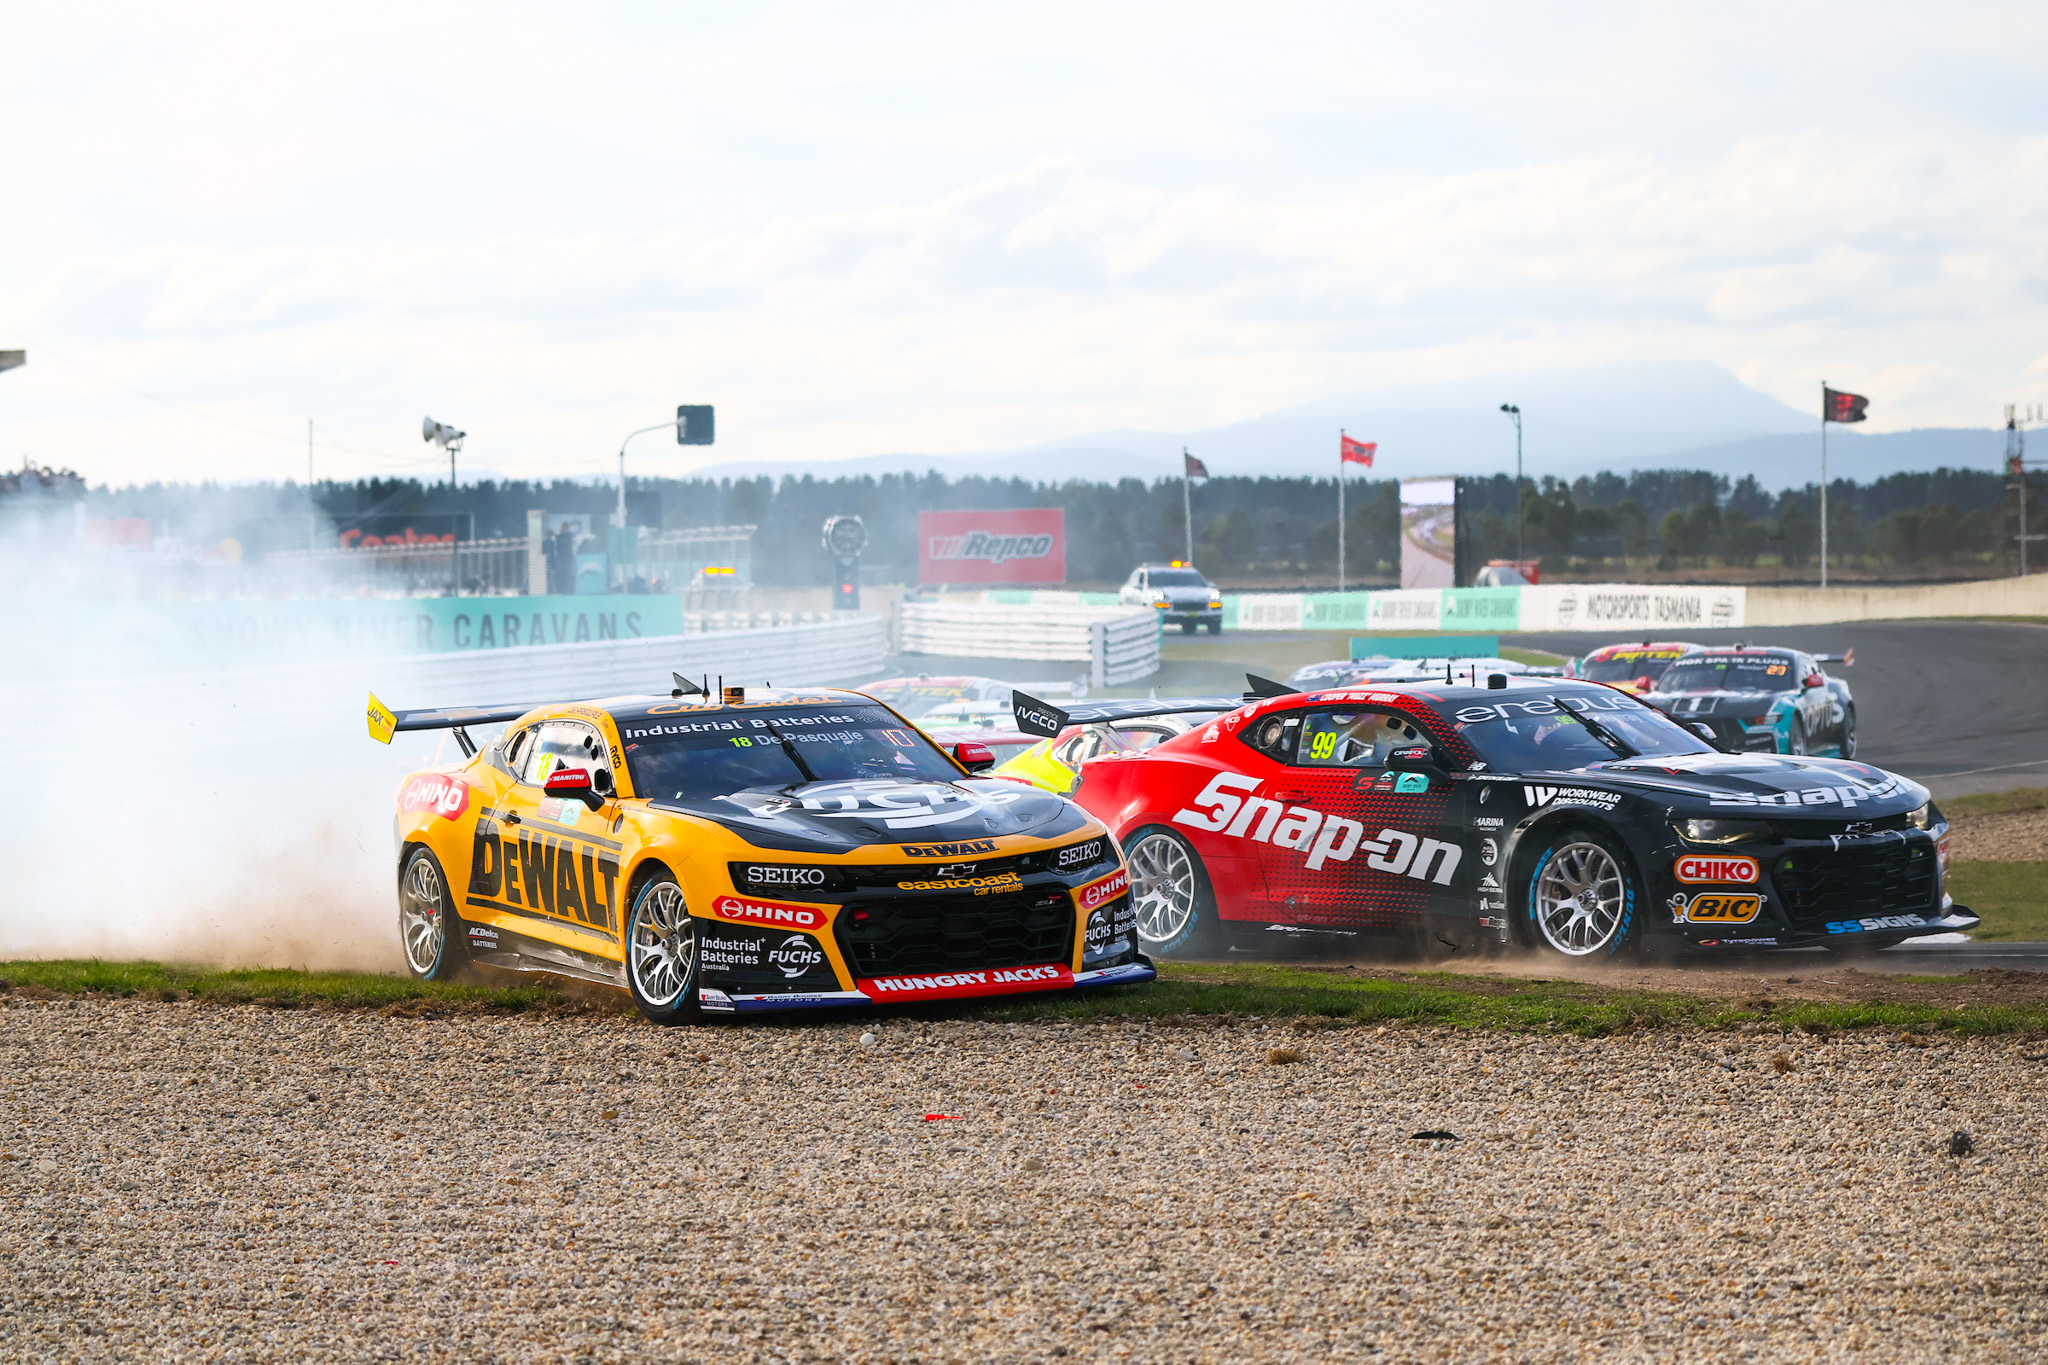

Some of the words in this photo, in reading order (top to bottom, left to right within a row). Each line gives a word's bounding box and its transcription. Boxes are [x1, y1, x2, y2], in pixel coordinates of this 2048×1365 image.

[965, 534, 1051, 560] Repco
[1587, 594, 1650, 620] MOTORSPORTS
[1655, 596, 1702, 622] TASMANIA
[453, 611, 643, 648] CARAVANS
[367, 707, 384, 726] JAX
[750, 714, 855, 729] Batteries
[1017, 706, 1057, 731] IVECO
[1038, 708, 1059, 720] PRESTIGE
[729, 736, 753, 748] 18
[784, 730, 864, 745] Pasquale
[1310, 731, 1337, 759] 99
[536, 752, 553, 780] 18
[610, 745, 622, 769] RYCO
[417, 783, 463, 811] HINO
[1552, 797, 1615, 811] DISCOUNTS
[1558, 787, 1621, 803] WORKWEAR
[1172, 771, 1463, 886] Snap-on
[1059, 841, 1101, 866] SEIKO
[748, 867, 824, 885] SEIKO
[1681, 860, 1753, 880] CHIKO
[897, 871, 1022, 890] eastcoast
[974, 886, 989, 896] car
[991, 882, 1024, 894] rentals
[746, 905, 815, 925] HINO
[469, 928, 499, 939] ACDelco
[1084, 924, 1111, 942] FUCHS
[473, 940, 497, 949] BATTERIES
[701, 950, 759, 965] Batteries
[768, 950, 821, 964] FUCHS
[701, 962, 730, 972] Australia
[873, 973, 986, 992] HUNGRY
